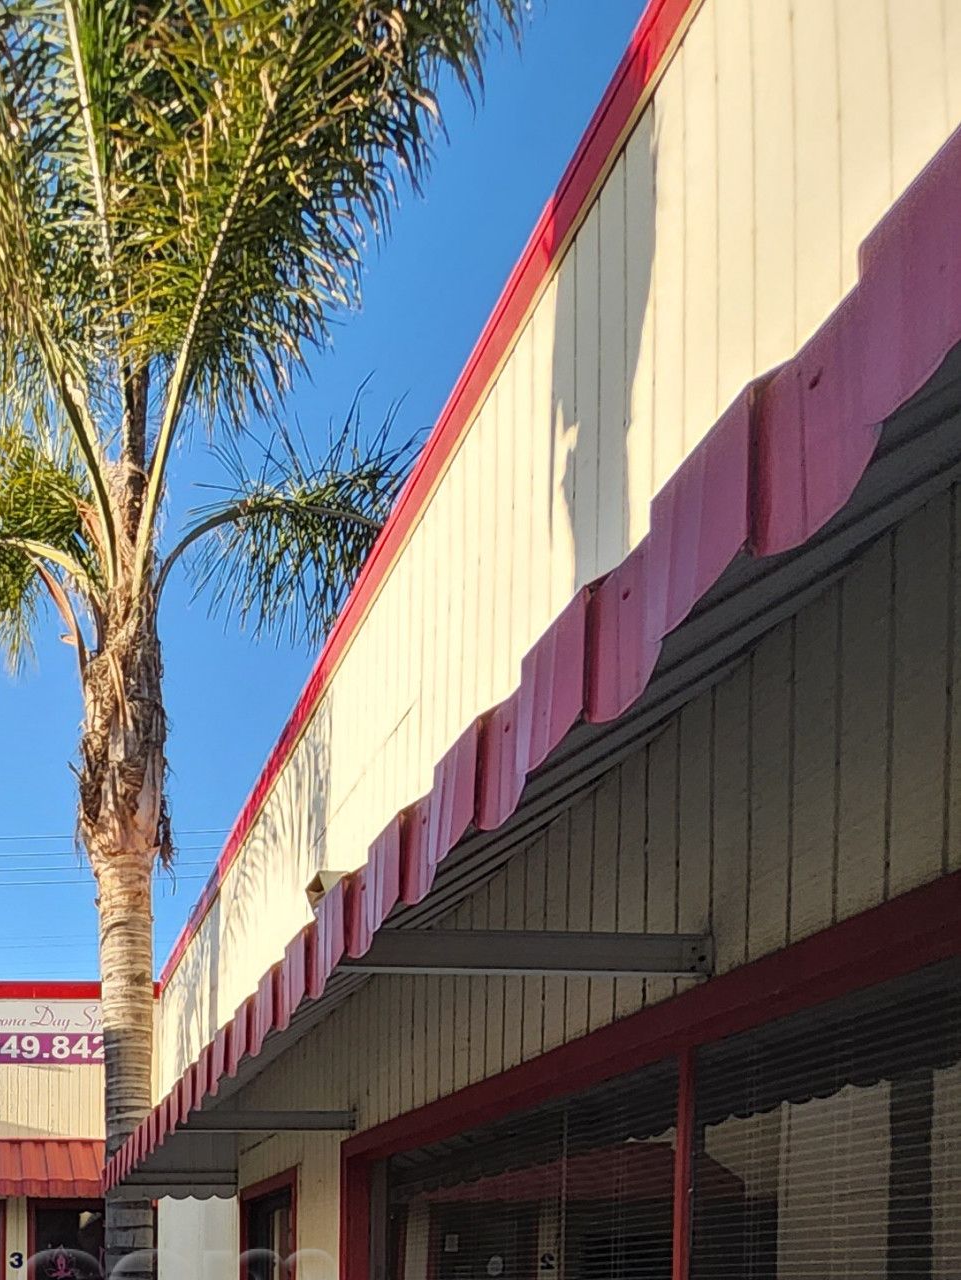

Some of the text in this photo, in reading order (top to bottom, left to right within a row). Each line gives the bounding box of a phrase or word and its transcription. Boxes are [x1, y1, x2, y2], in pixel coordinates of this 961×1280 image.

[28, 1004, 71, 1032] Day
[74, 1005, 103, 1033] Sp
[9, 1251, 24, 1269] 3
